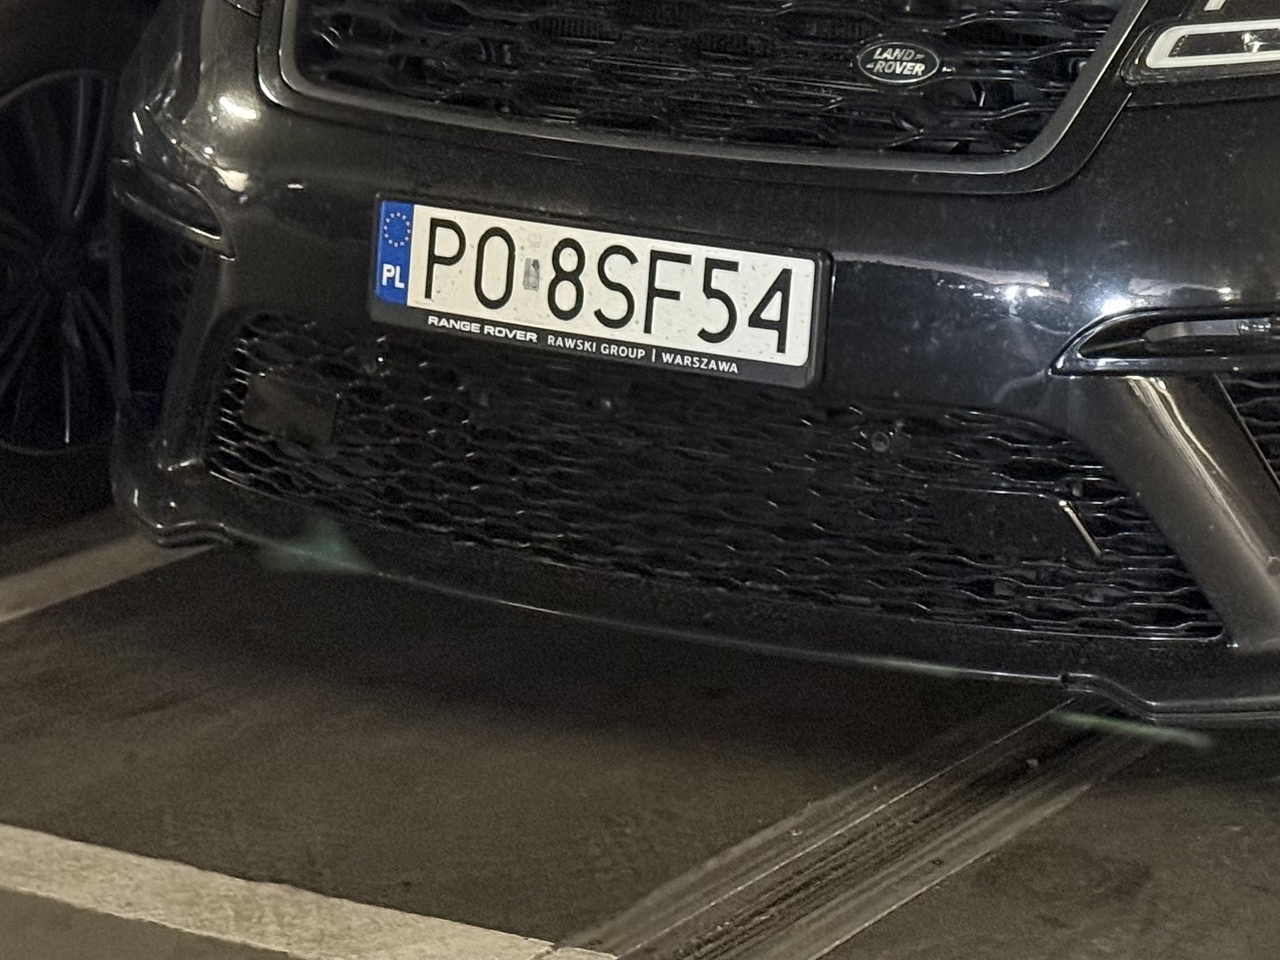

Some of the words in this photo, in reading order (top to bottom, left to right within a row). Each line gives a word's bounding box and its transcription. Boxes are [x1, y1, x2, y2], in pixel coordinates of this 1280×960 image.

[873, 48, 915, 61] LAND
[873, 61, 925, 76] ROVER
[382, 263, 405, 289] PL
[424, 217, 516, 310] PO
[547, 238, 793, 354] 8SF54
[427, 315, 481, 334] RANGE
[484, 325, 538, 342] ROVER
[547, 335, 597, 353] RAWSKI
[600, 343, 646, 360] GROUP
[661, 352, 739, 374] WARSZAWA
